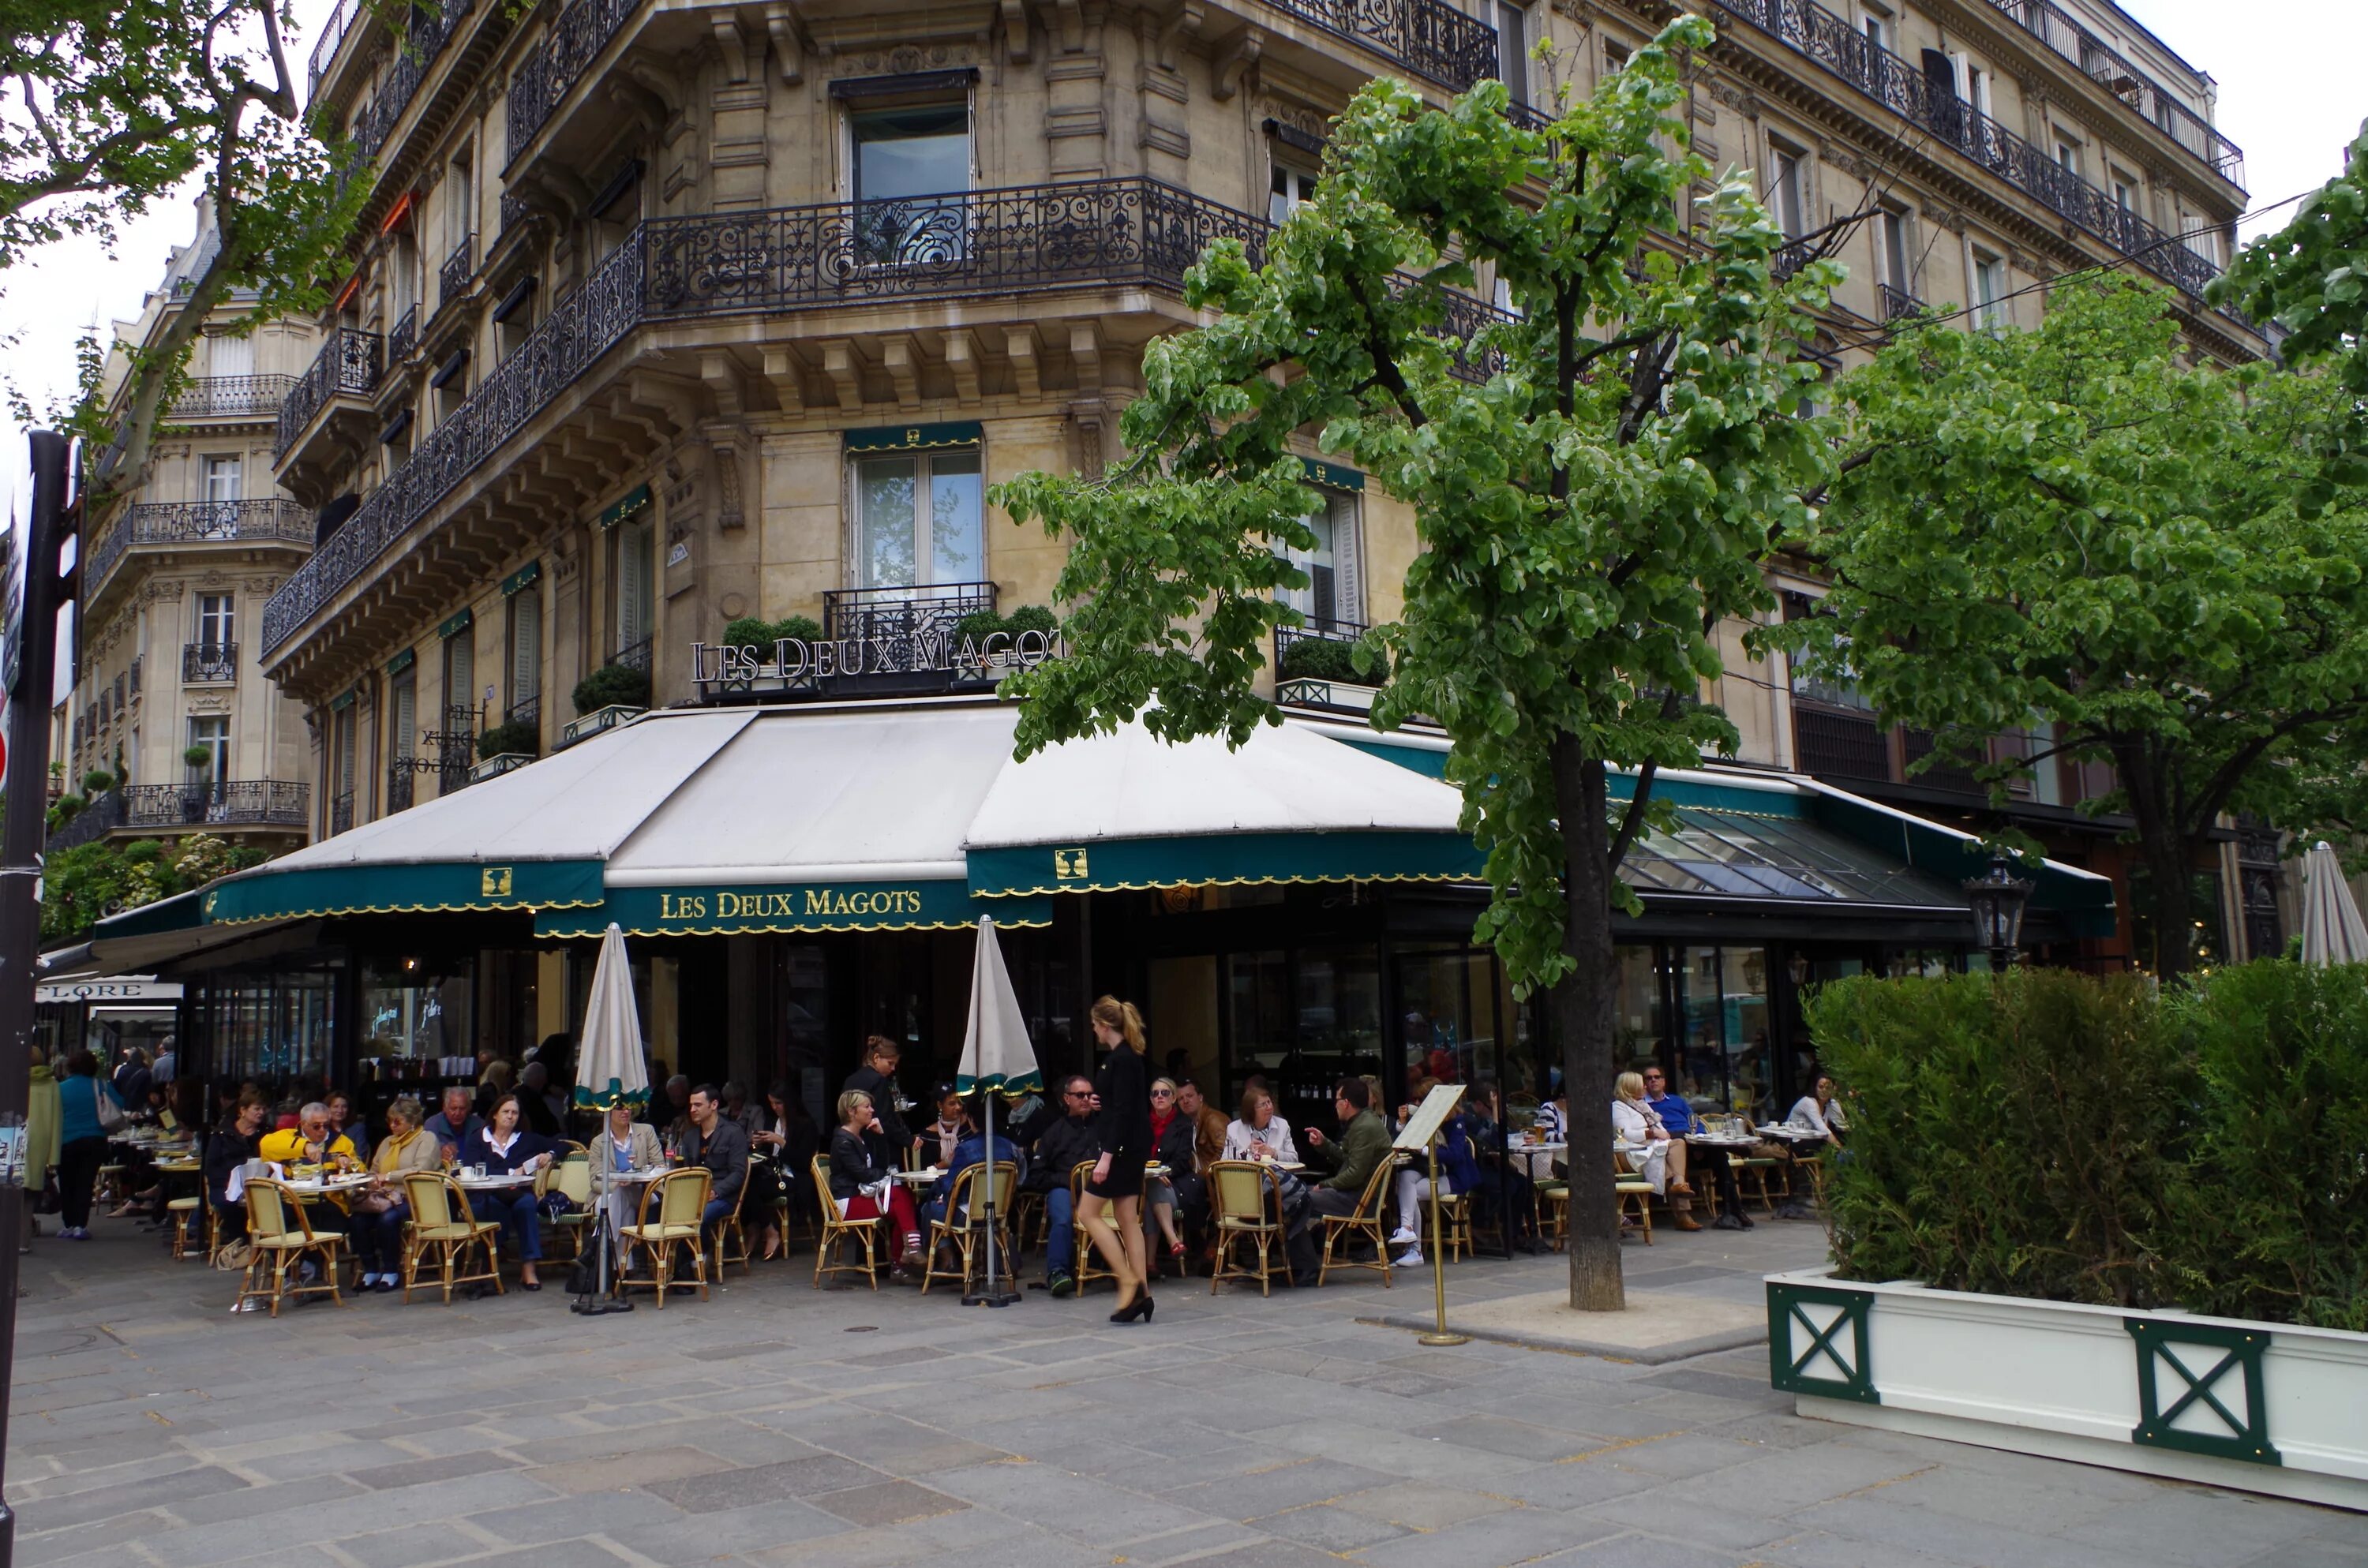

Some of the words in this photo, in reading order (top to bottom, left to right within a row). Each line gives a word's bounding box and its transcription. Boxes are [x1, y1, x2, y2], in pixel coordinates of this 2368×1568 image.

[690, 642, 759, 682] LES
[773, 637, 898, 679] DEUX
[910, 627, 1066, 672] MAGOT
[660, 893, 706, 919] LES
[716, 893, 794, 918] DEUX
[804, 889, 921, 915] MAGOTS
